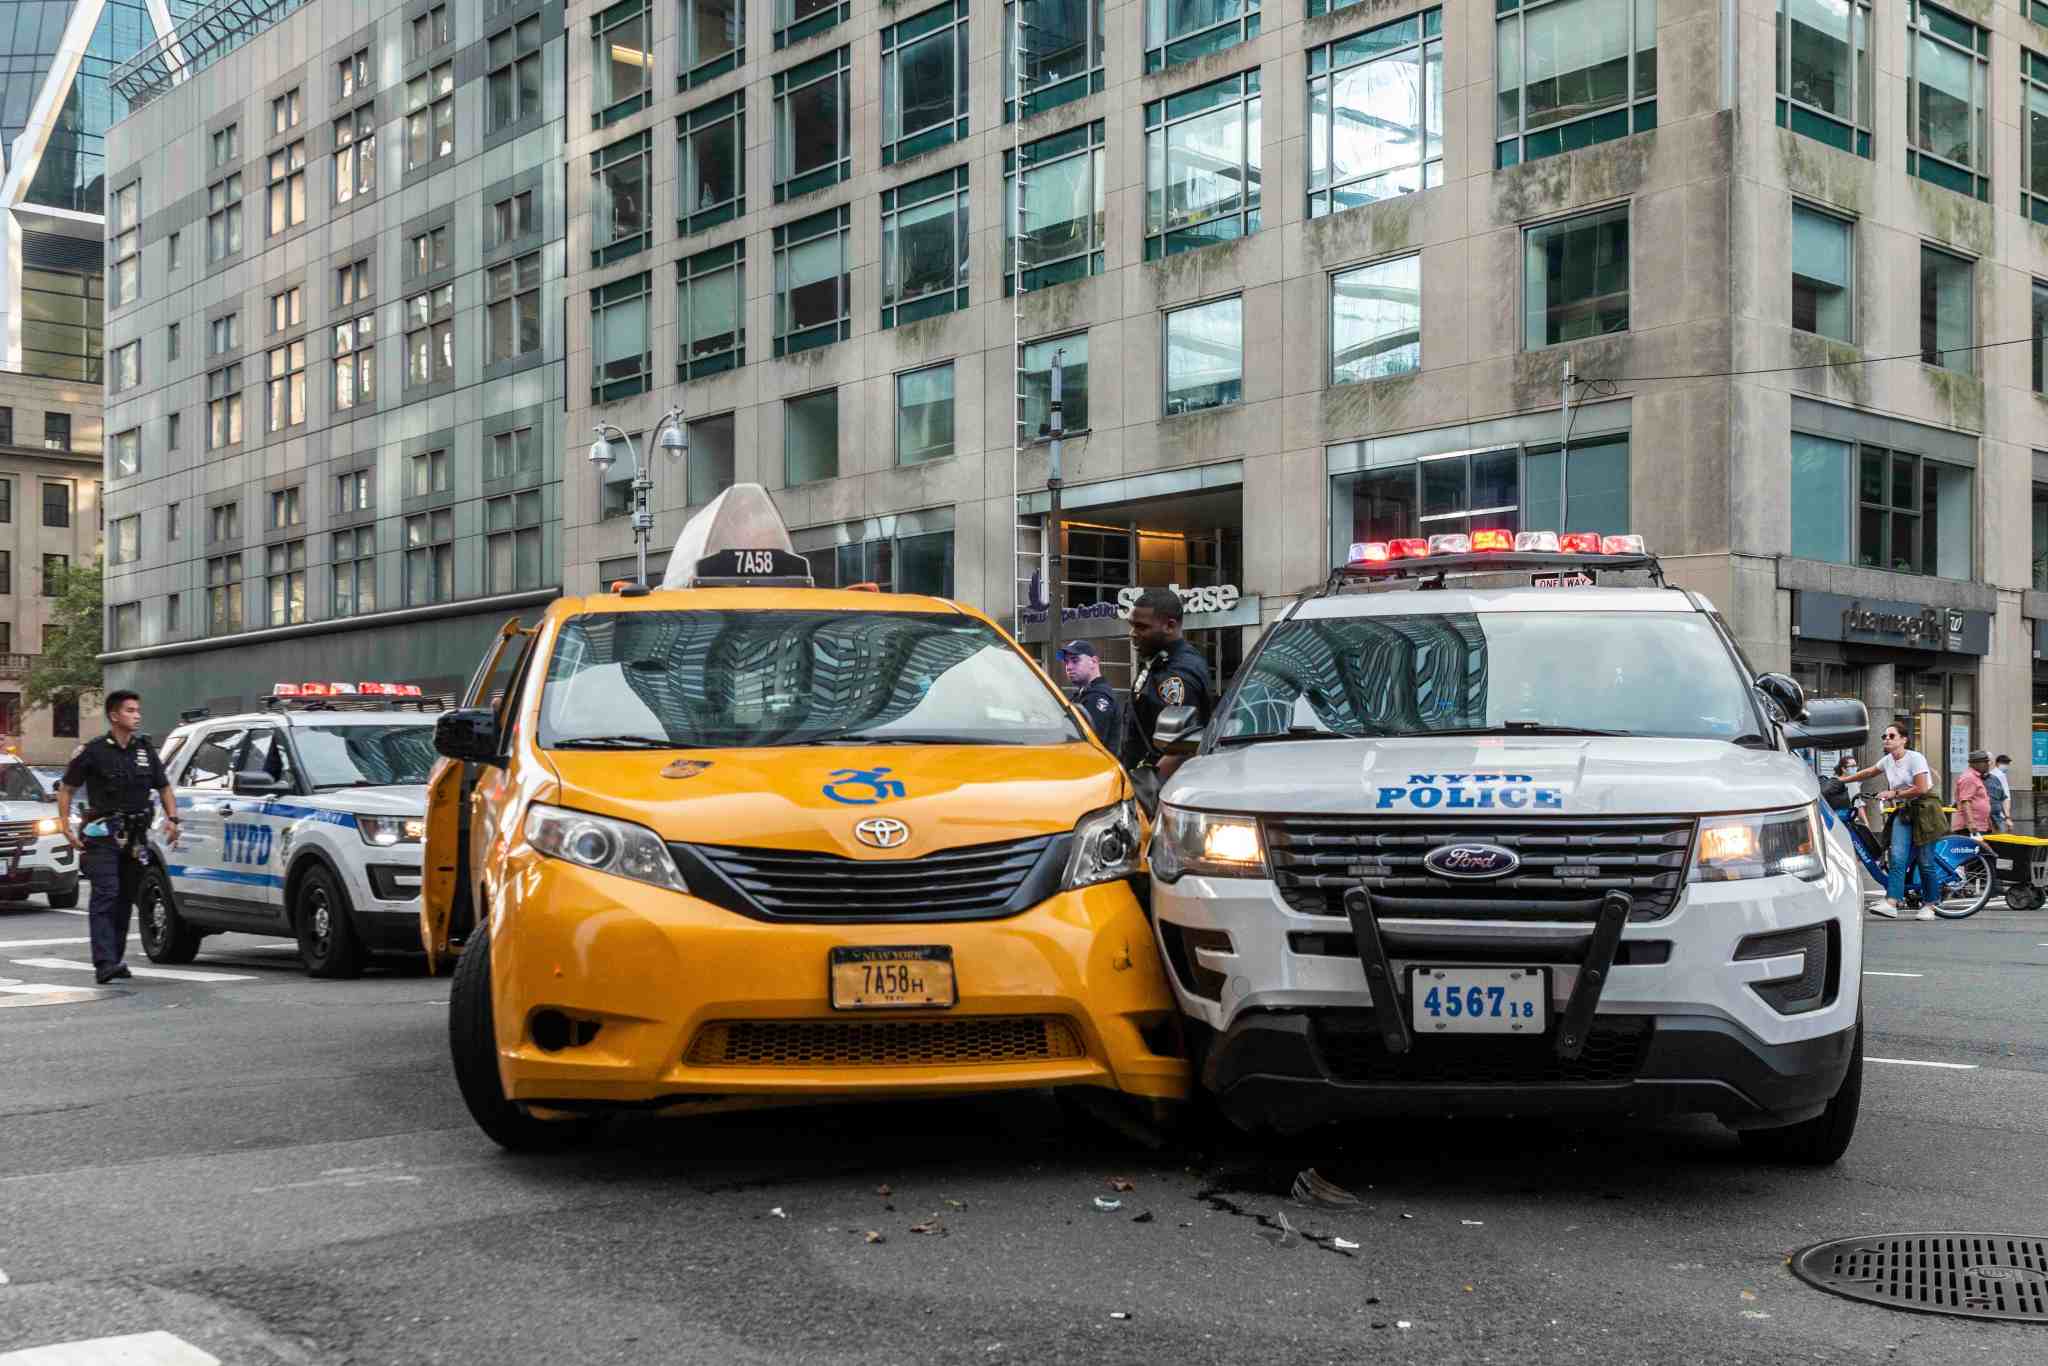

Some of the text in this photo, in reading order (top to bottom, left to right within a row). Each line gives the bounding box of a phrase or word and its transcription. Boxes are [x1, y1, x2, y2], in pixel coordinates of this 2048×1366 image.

[735, 551, 773, 573] 7A58
[1407, 774, 1533, 784] NYPD
[1376, 787, 1562, 808] POLICE
[222, 822, 272, 865] NYPD
[1446, 848, 1497, 867] Ford
